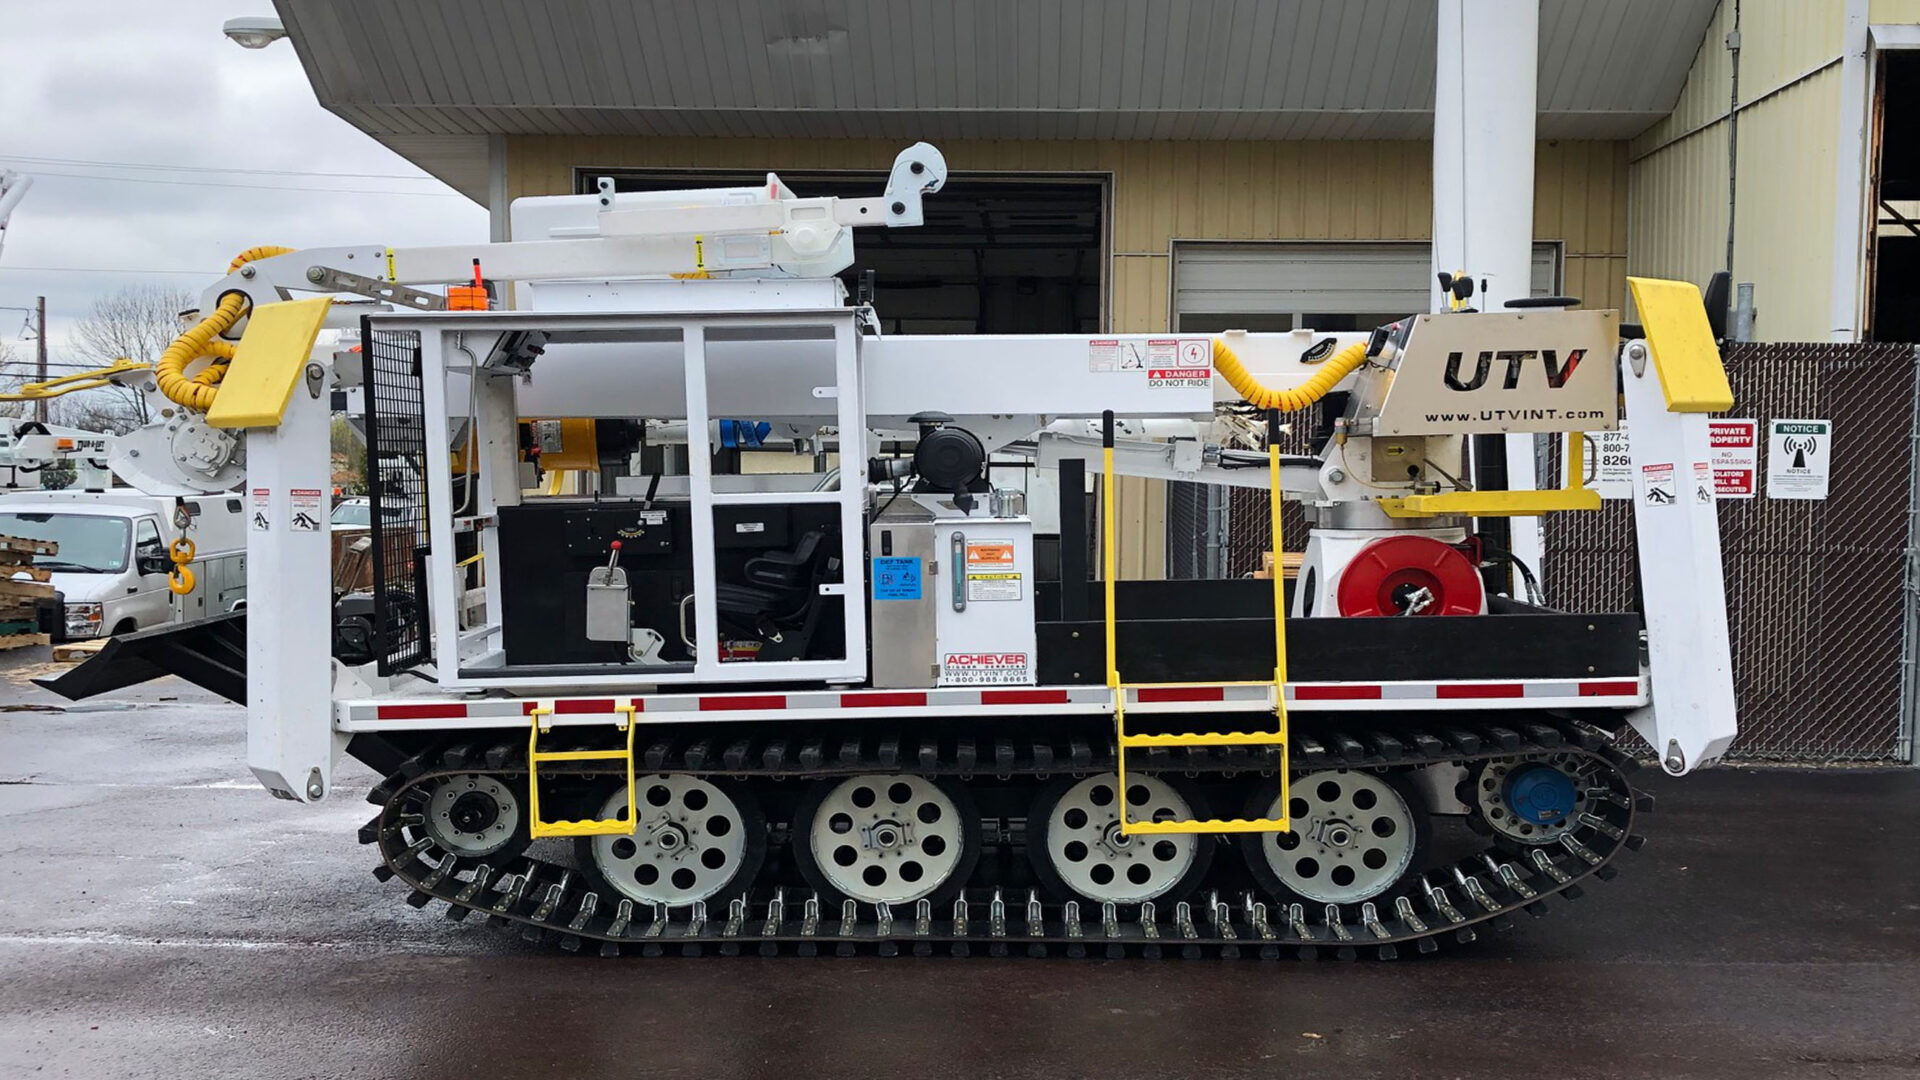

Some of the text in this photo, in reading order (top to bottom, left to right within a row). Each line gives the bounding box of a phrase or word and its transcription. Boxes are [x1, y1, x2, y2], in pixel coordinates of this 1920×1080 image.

[1165, 370, 1206, 378] DANGER
[1443, 349, 1588, 392] UTV
[1165, 379, 1184, 387] NOT
[1425, 409, 1605, 422] www.UTVINT.com
[1783, 425, 1819, 433] NOTICE
[1602, 455, 1631, 466] 826
[947, 654, 1026, 665] ACHIEVER
